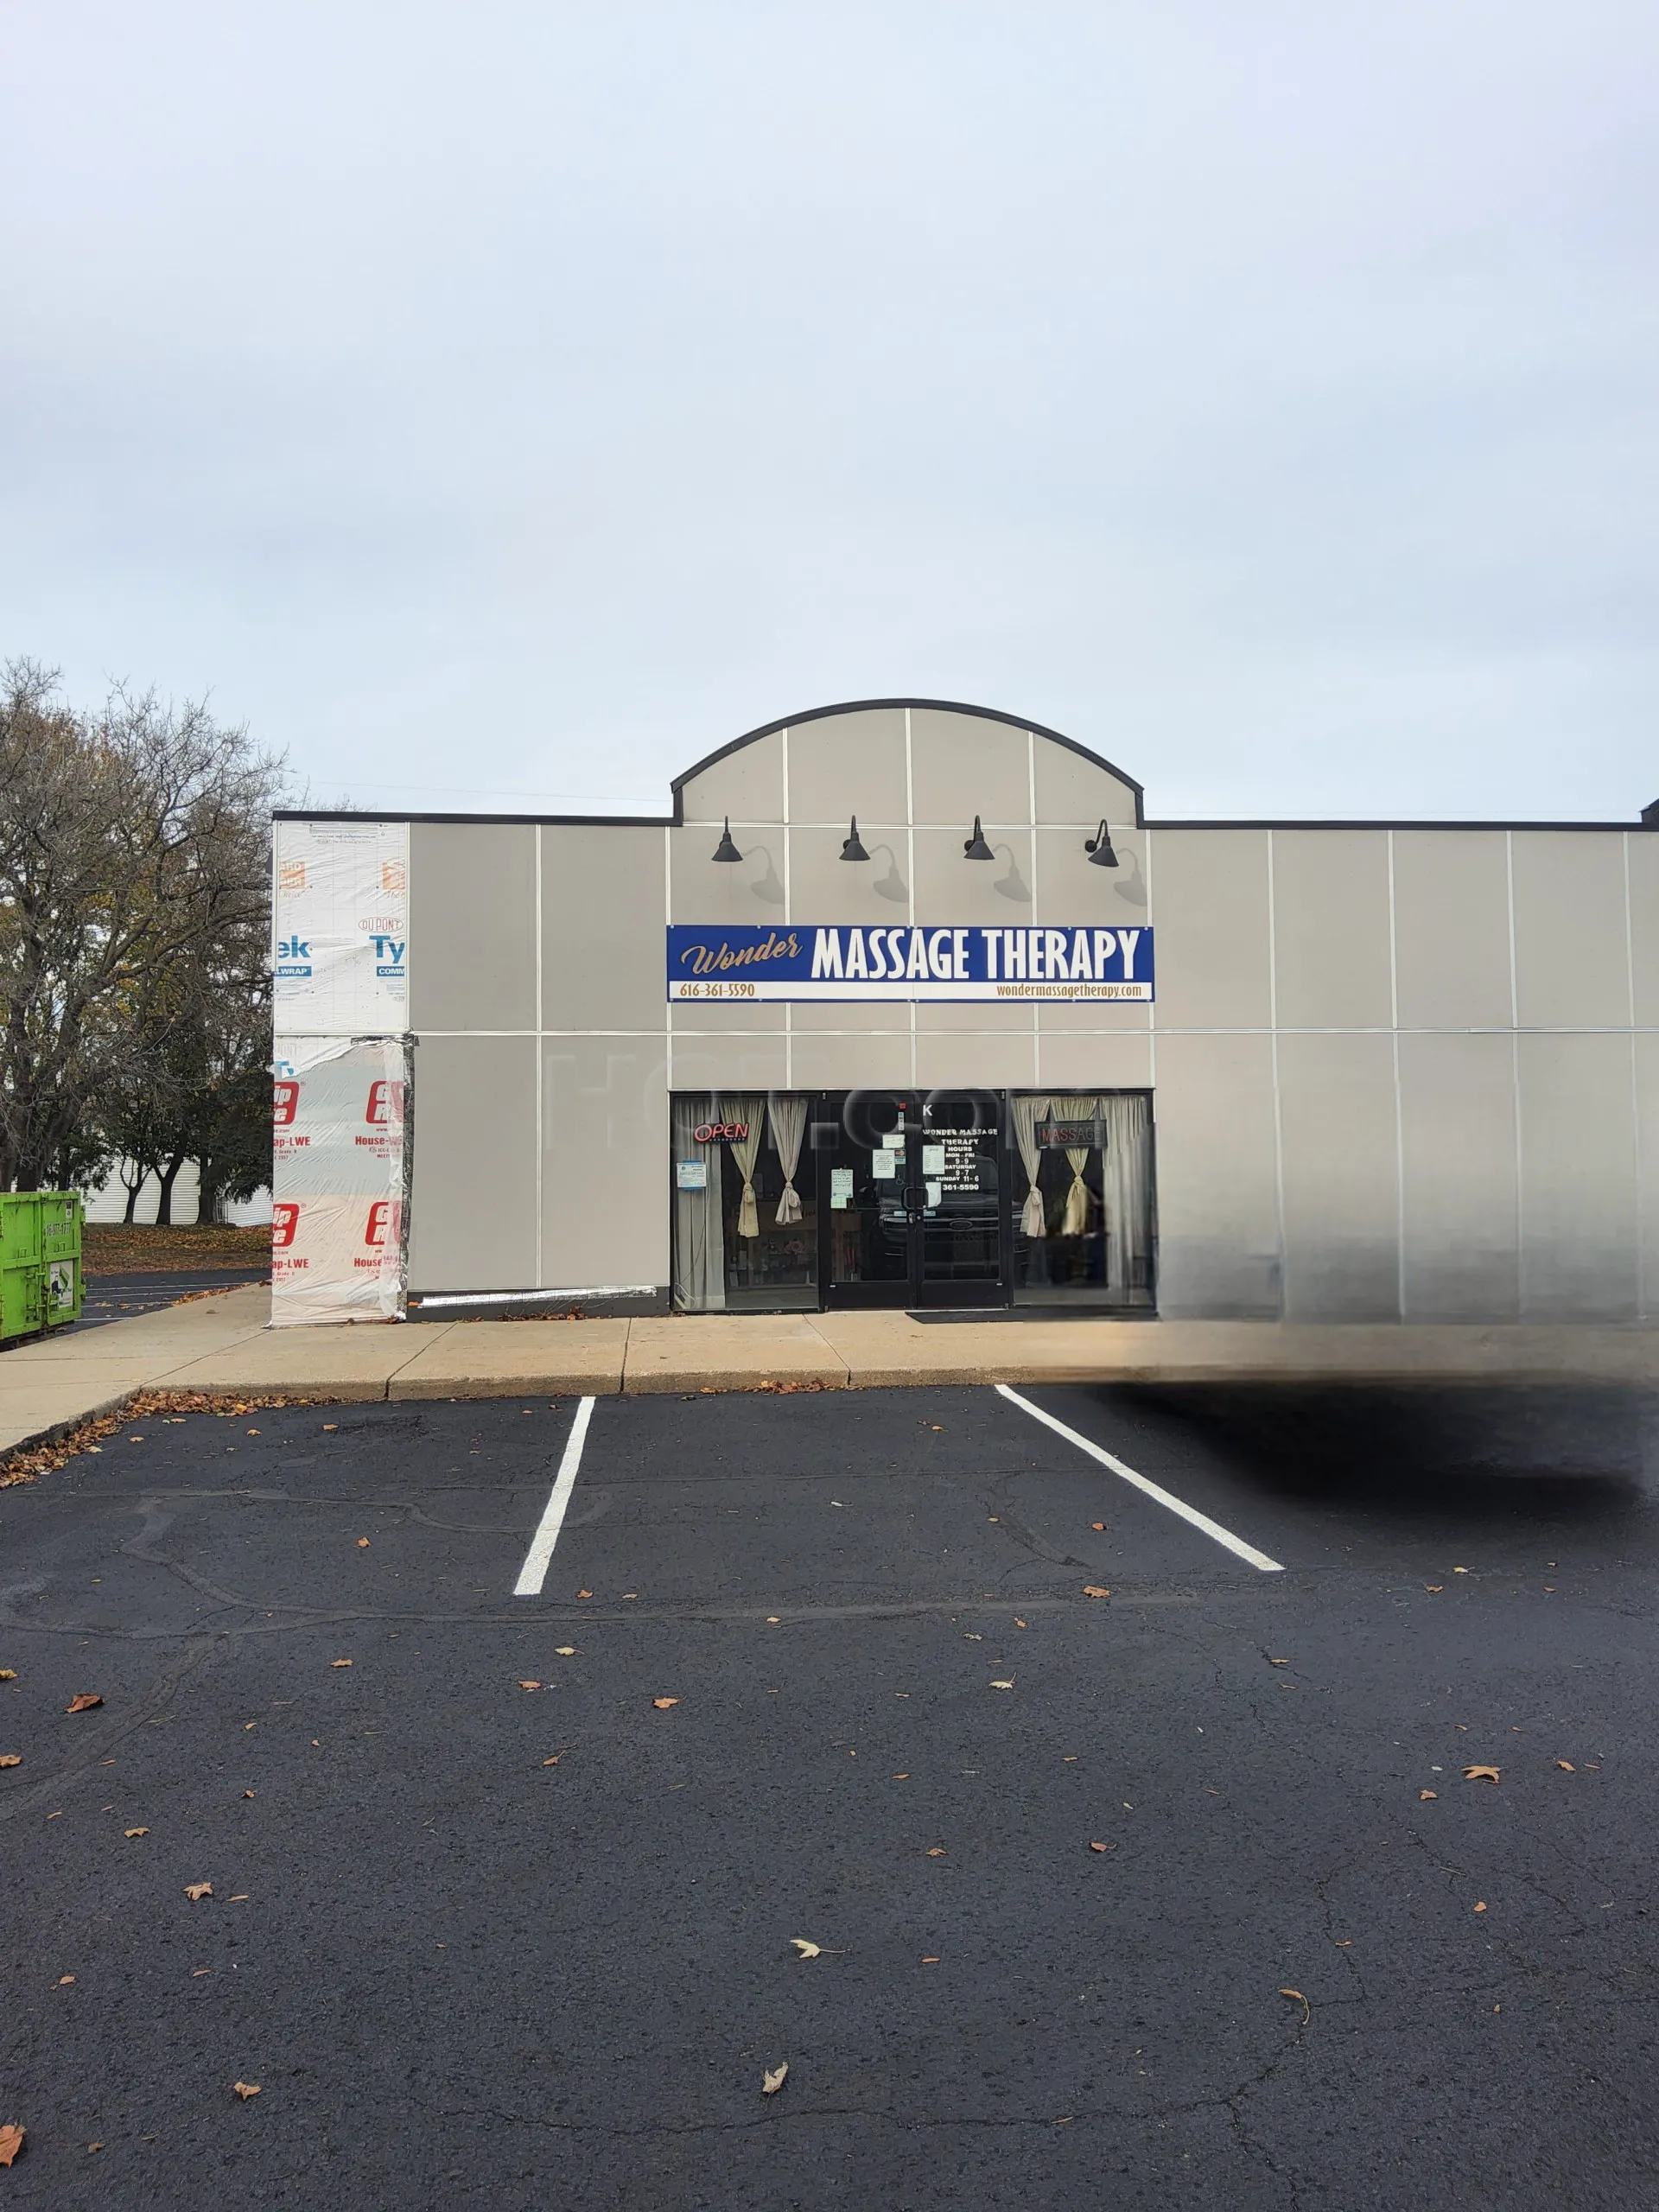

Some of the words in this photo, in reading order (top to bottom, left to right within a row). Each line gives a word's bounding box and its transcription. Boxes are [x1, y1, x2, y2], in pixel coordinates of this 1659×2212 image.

[277, 935, 312, 958] ek
[369, 935, 405, 964] Ty
[681, 932, 804, 975] Wonder
[811, 928, 969, 979] MASSAGE
[981, 929, 1141, 979] THERAPY
[680, 983, 755, 997] 616-361-5590
[996, 983, 1142, 999] wondermassagetherapy.com
[923, 1104, 933, 1116] K
[694, 1122, 749, 1142] OPEN
[1042, 1127, 1101, 1141] MASSAGE
[274, 1136, 311, 1148] ap-LWE
[272, 1258, 309, 1270] ap-LWE
